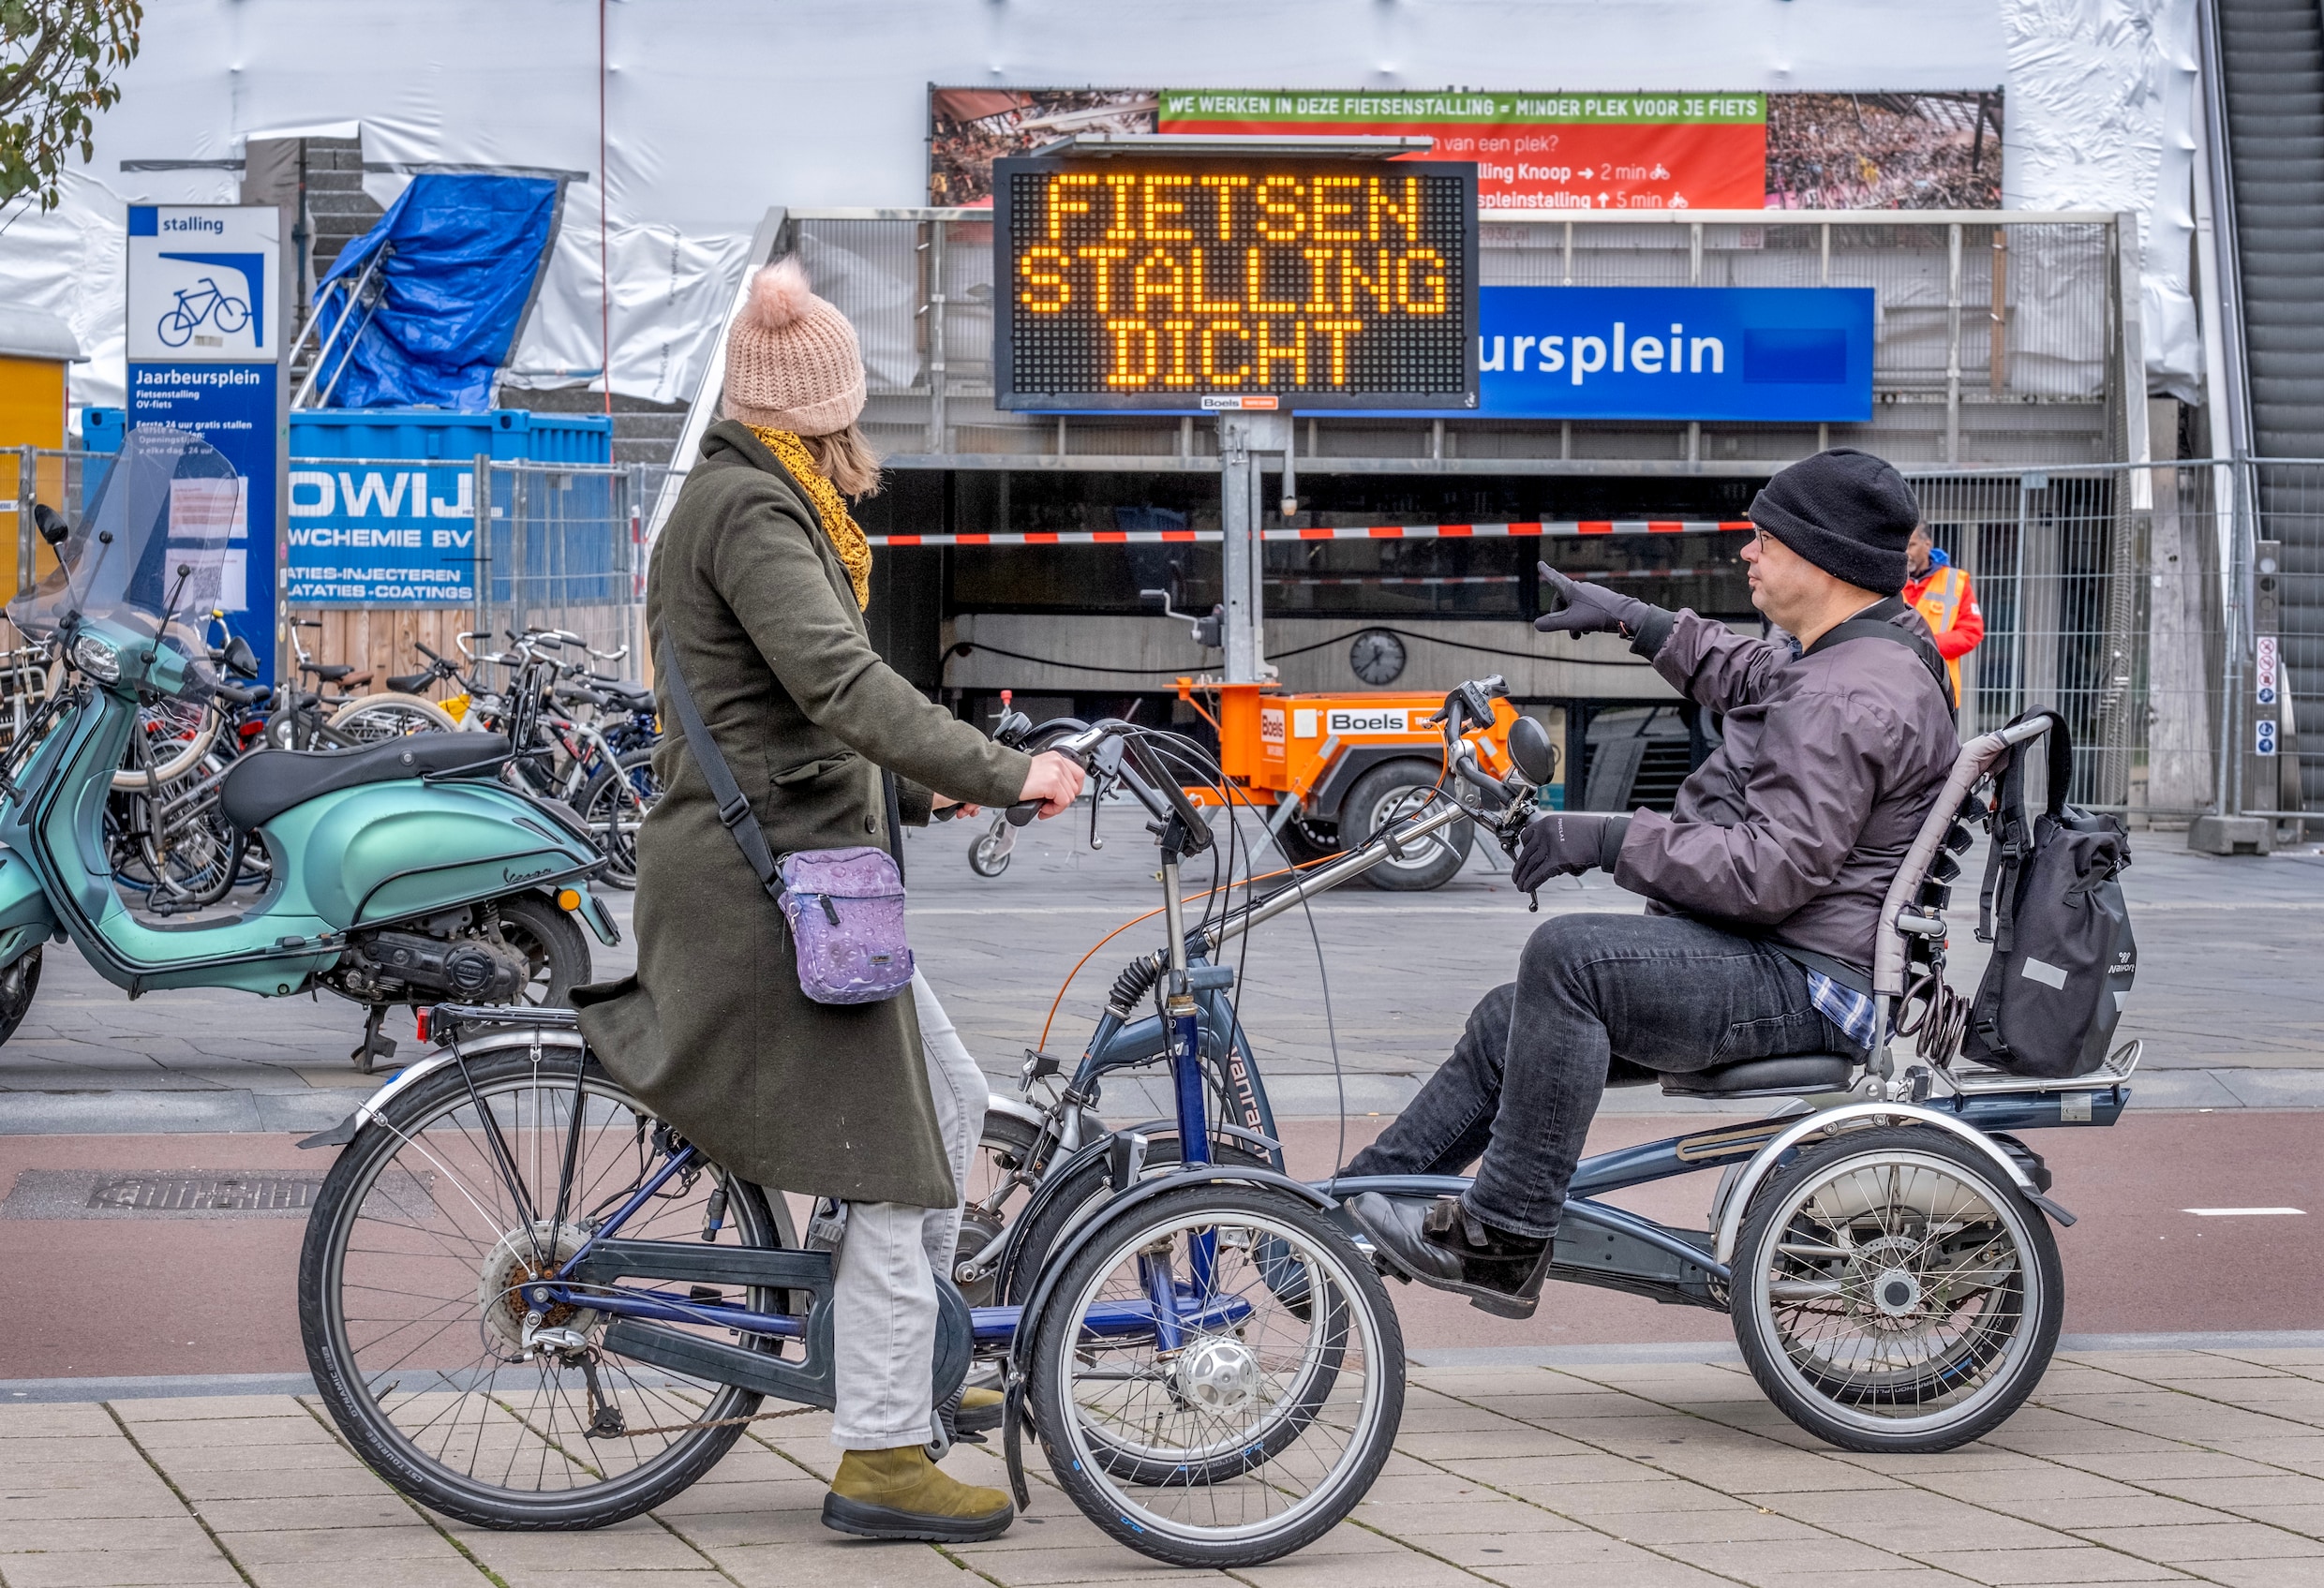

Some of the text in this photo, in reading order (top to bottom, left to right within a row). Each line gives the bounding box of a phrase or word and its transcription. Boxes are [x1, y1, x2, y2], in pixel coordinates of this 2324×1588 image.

[1169, 96, 1195, 113] WE
[1199, 96, 1271, 114] WERKEN
[1275, 97, 1293, 114] IN
[1297, 97, 1339, 115] DEZE
[1344, 97, 1495, 116] FIETSENSTALLING
[1515, 98, 1580, 116] MINDER
[1585, 99, 1628, 116] PLEK
[1632, 99, 1678, 116] VOOR
[1683, 99, 1705, 116] JE
[1708, 99, 1758, 116] FIETS
[1444, 139, 1474, 152] van
[1478, 138, 1511, 152] een
[1514, 135, 1559, 156] plek?
[1518, 164, 1572, 185] Knoop
[1600, 164, 1612, 180] 2
[1615, 163, 1646, 180] min
[1049, 174, 1418, 241] FIETSEN
[1616, 192, 1626, 208] 5
[1631, 192, 1662, 208] min
[163, 216, 224, 234] stalling
[1020, 247, 1446, 314] STALLING
[1106, 319, 1363, 385] DICHT
[1479, 321, 1724, 386] ursplein
[135, 369, 261, 388] Jaarbeursplein
[136, 390, 201, 401] Fietsenstalling
[136, 400, 172, 408] OV-fiets
[1204, 398, 1240, 408] Boels
[195, 421, 221, 431] gratis
[223, 421, 252, 429] stallen
[288, 527, 473, 548] WCHEMIE BV
[1262, 714, 1283, 737] Boels
[1332, 714, 1404, 730] Boels
[330, 1372, 359, 1417] DYNAMIC
[405, 1467, 424, 1483] CST
